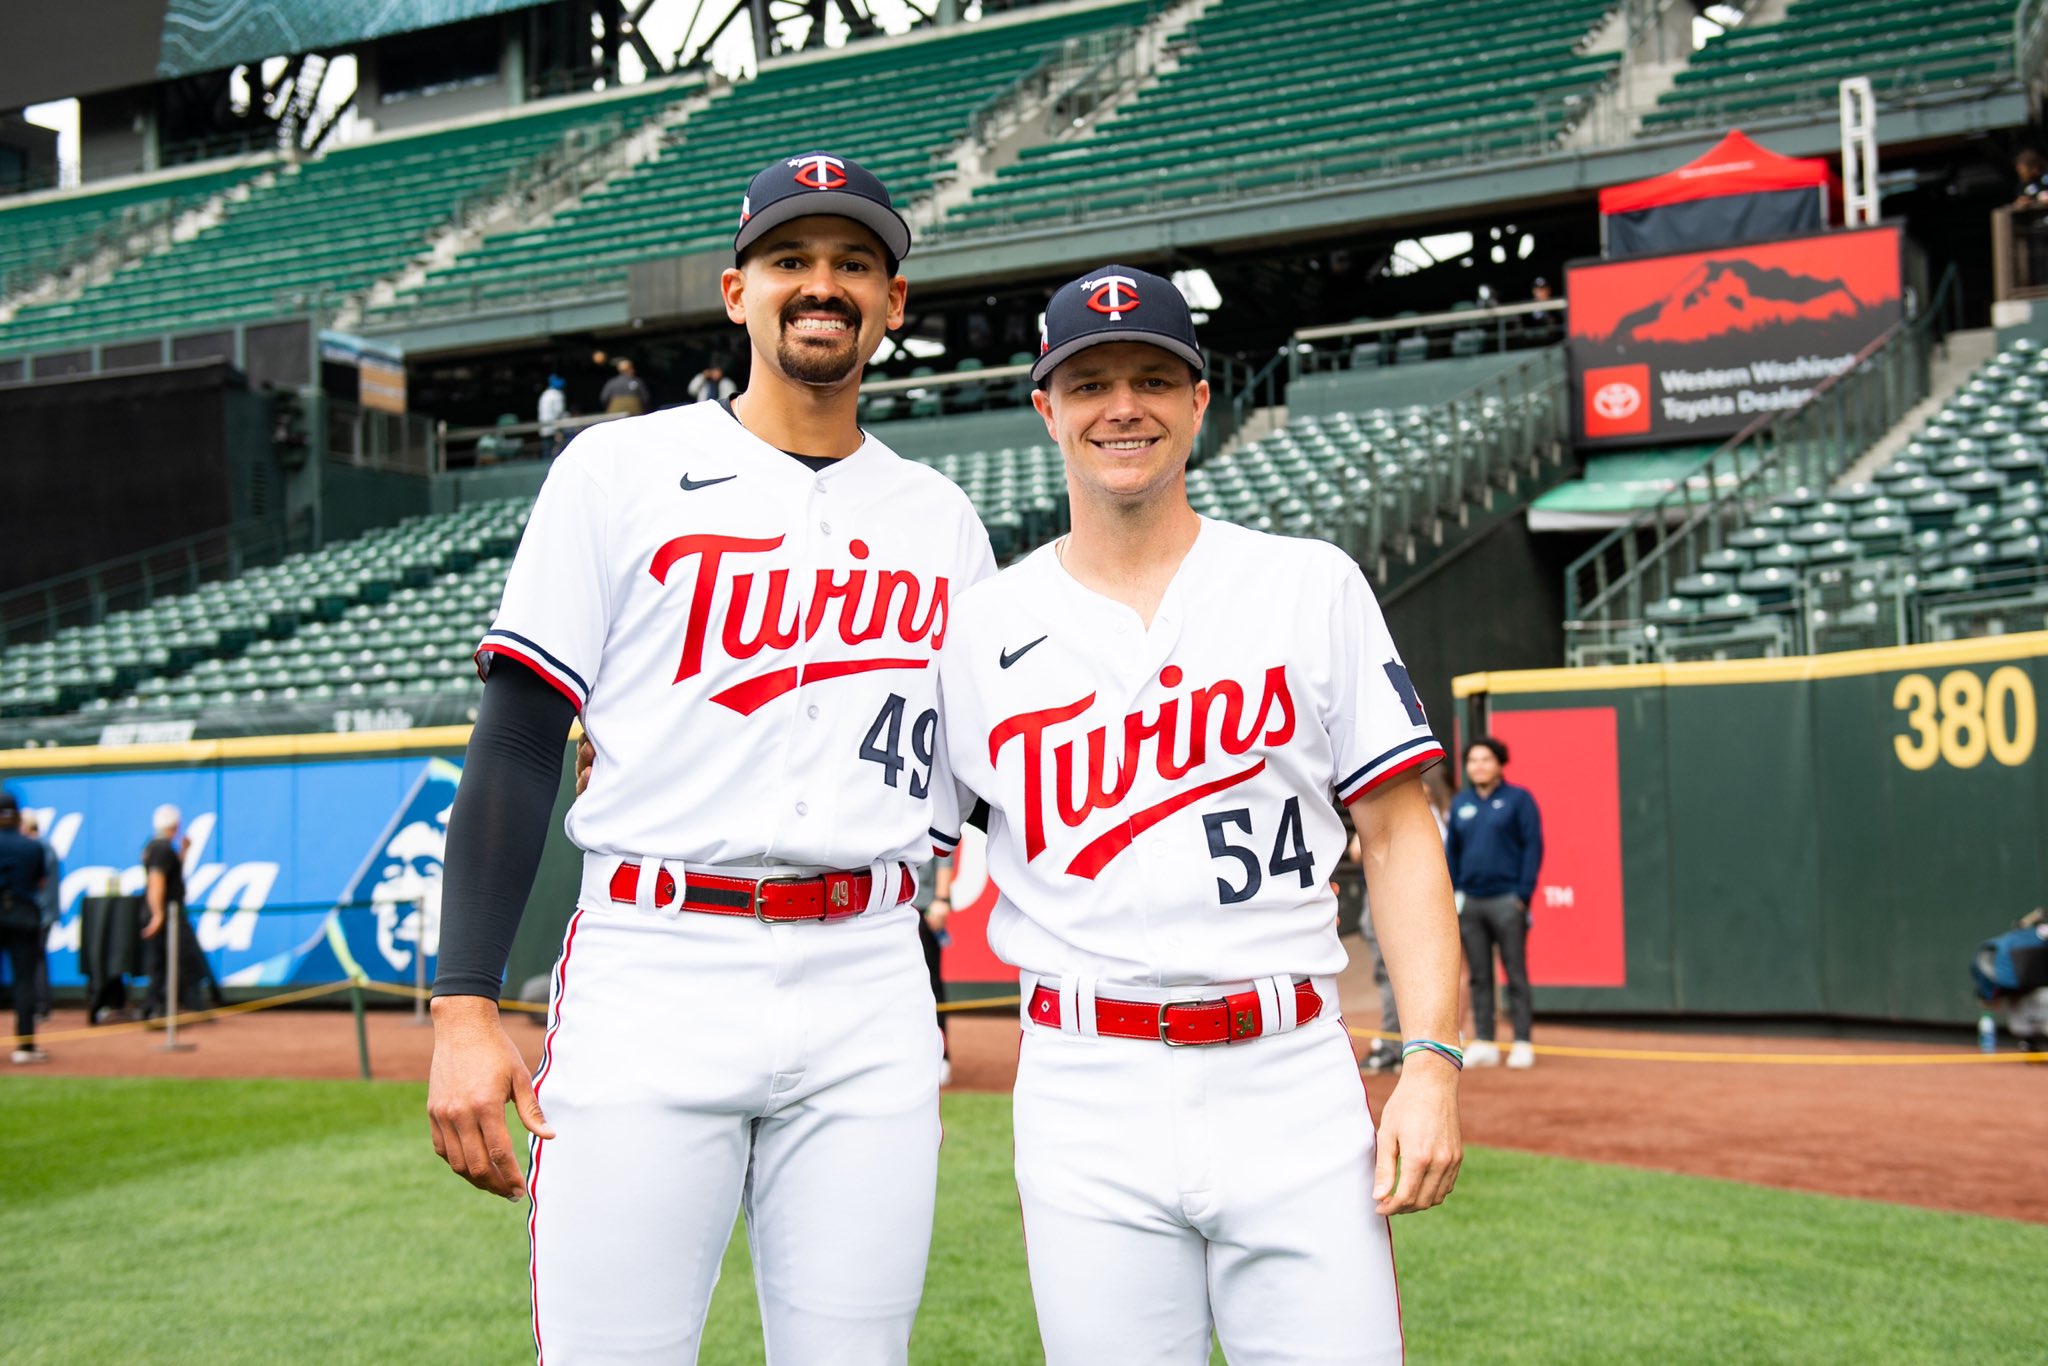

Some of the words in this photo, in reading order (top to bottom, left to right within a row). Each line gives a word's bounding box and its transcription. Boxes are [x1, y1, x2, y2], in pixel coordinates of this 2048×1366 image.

[1660, 367, 1751, 393] Western
[1661, 395, 1736, 423] Toyota
[1737, 385, 1816, 413] Dealer
[649, 533, 949, 686] Twins
[859, 692, 938, 800] 49
[989, 665, 1296, 864] Twins
[1893, 666, 2037, 771] 380
[831, 880, 849, 907] 49
[1202, 796, 1315, 905] 54
[1236, 1009, 1255, 1037] 54
